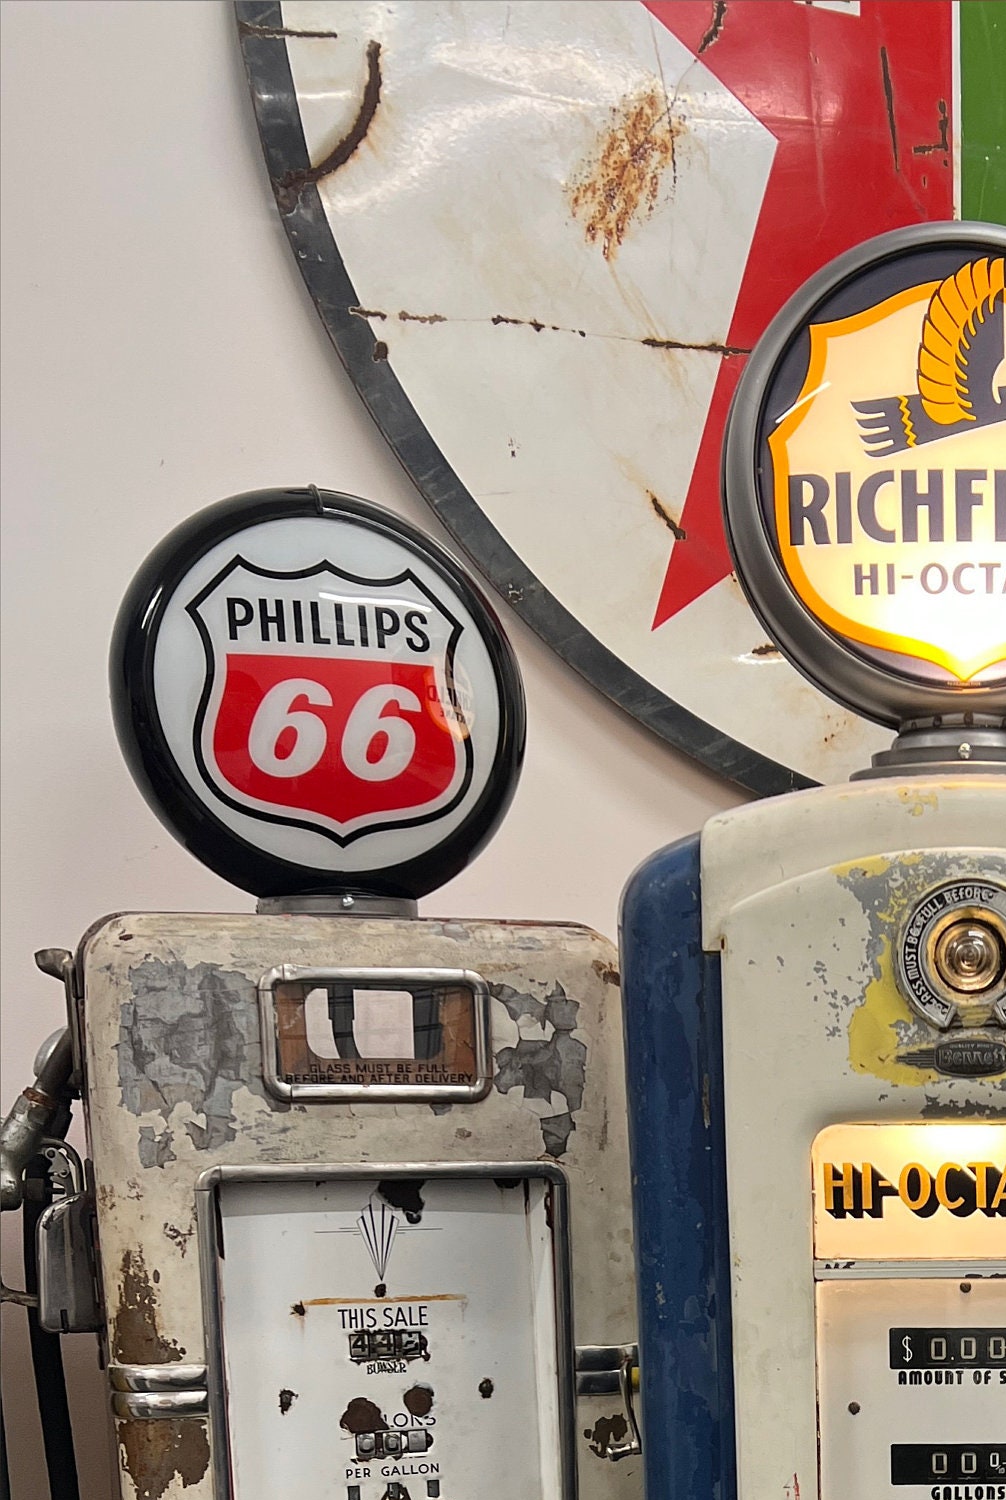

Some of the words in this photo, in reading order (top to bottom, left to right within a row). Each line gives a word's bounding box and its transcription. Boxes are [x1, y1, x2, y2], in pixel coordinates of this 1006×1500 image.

[226, 597, 430, 653] PHILLIPS
[248, 678, 422, 782] 66
[905, 946, 920, 981] MUST
[310, 1064, 350, 1073] GLASS
[356, 1064, 389, 1073] MUST
[396, 1065, 412, 1073] BE
[418, 1065, 448, 1073] FULL
[286, 1075, 335, 1083] BEFORE
[341, 1075, 364, 1083] AND
[370, 1075, 408, 1083] AFTER
[415, 1075, 473, 1083] DELIVERY
[338, 1308, 377, 1328] THIS
[383, 1306, 429, 1327] SALE
[898, 1371, 963, 1385] AMOUNT
[973, 1370, 991, 1384] OF
[346, 1468, 371, 1479] PER
[381, 1463, 440, 1476] GALLON
[931, 1486, 1006, 1500] GALLONS
